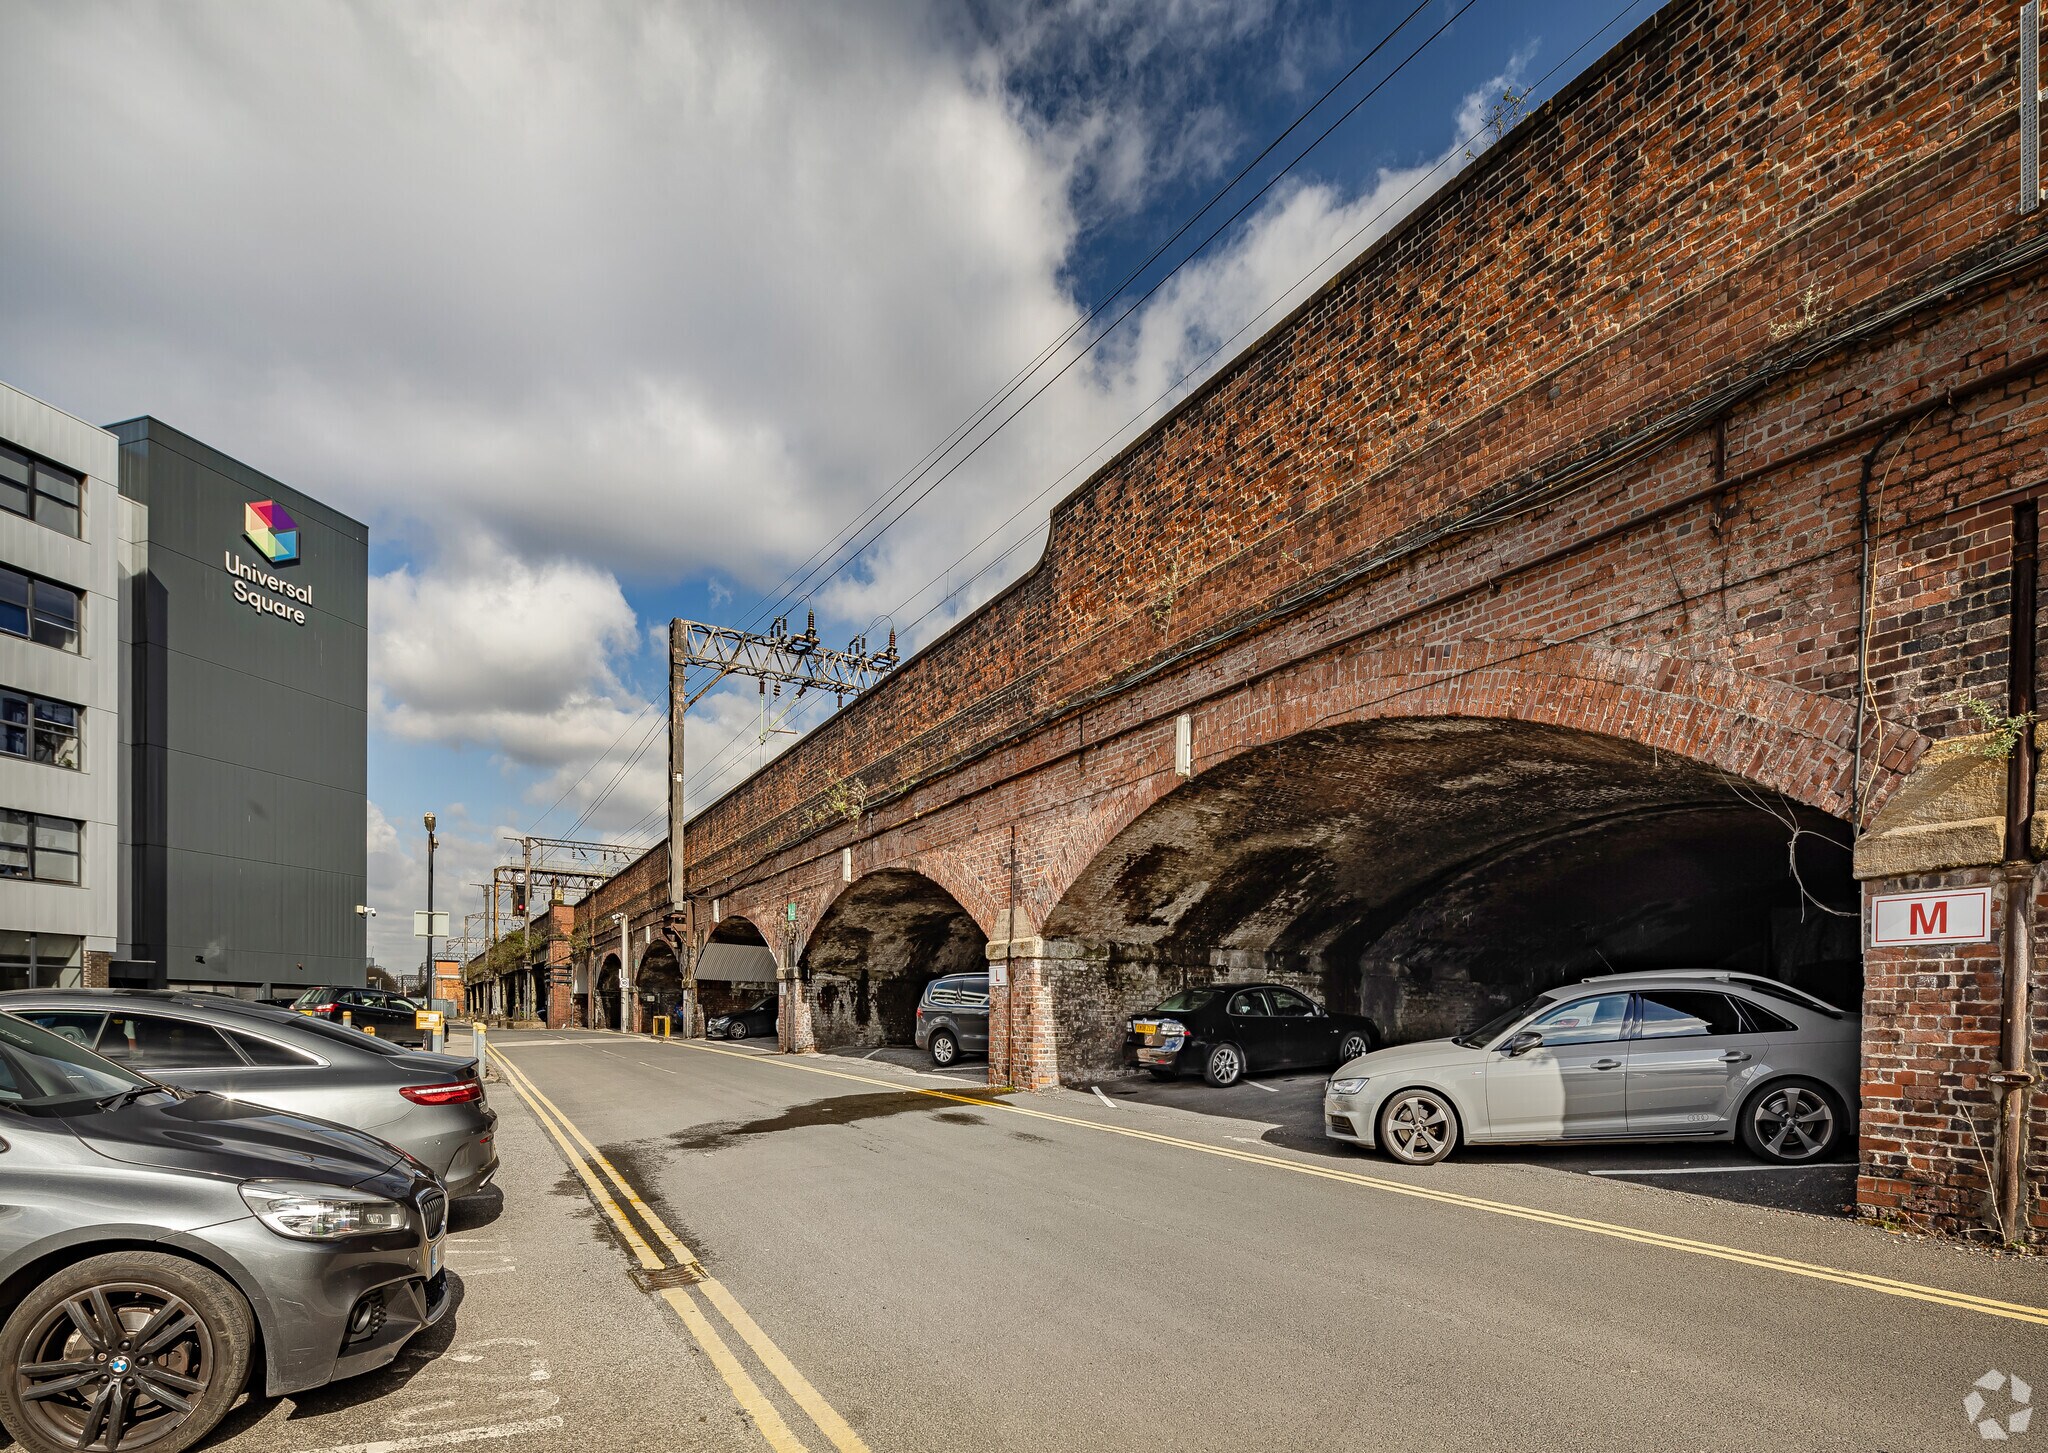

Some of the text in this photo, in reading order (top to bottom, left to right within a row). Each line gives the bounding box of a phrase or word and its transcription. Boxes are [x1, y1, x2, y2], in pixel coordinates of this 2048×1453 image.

[225, 551, 312, 605] Universal
[233, 580, 305, 624] Square
[1910, 901, 1948, 935] M
